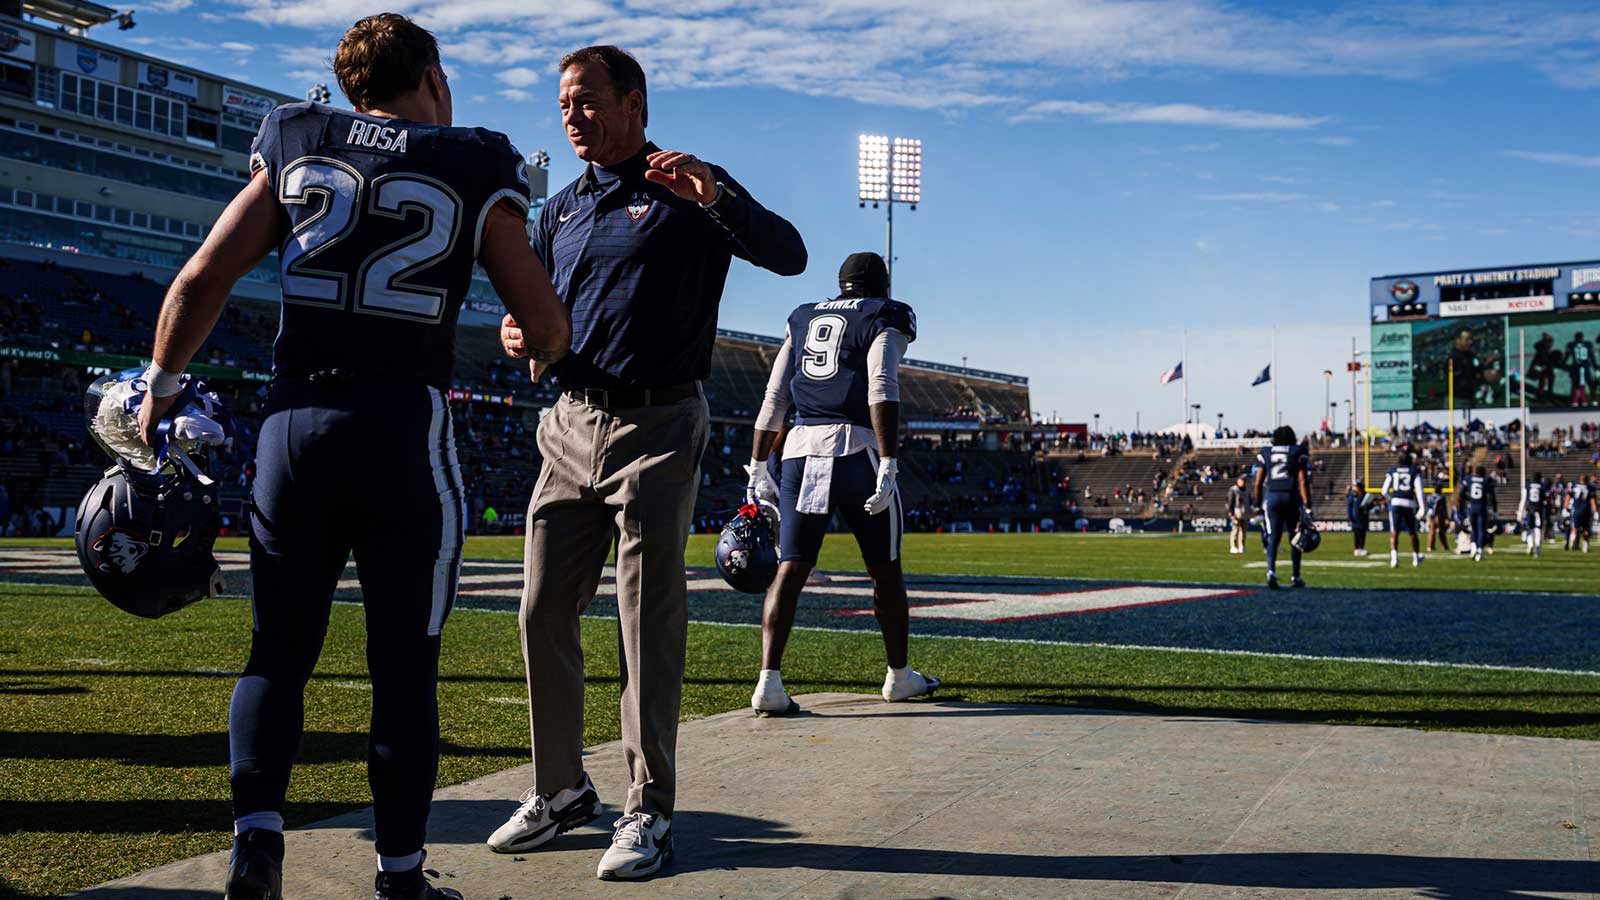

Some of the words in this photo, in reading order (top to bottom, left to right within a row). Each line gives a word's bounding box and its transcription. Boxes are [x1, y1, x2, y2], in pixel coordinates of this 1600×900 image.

[346, 119, 409, 153] ROSA
[279, 155, 464, 326] 22
[1433, 274, 1463, 286] PRATT
[1465, 273, 1473, 284] &
[1475, 270, 1516, 283] WHITNEY
[1518, 267, 1559, 280] STADIUM
[1507, 299, 1545, 309] xerox
[802, 313, 848, 381] 9
[1270, 453, 1289, 480] 2
[1392, 472, 1411, 491] 13
[1470, 482, 1483, 499] 6
[1191, 517, 1227, 527] UCONN
